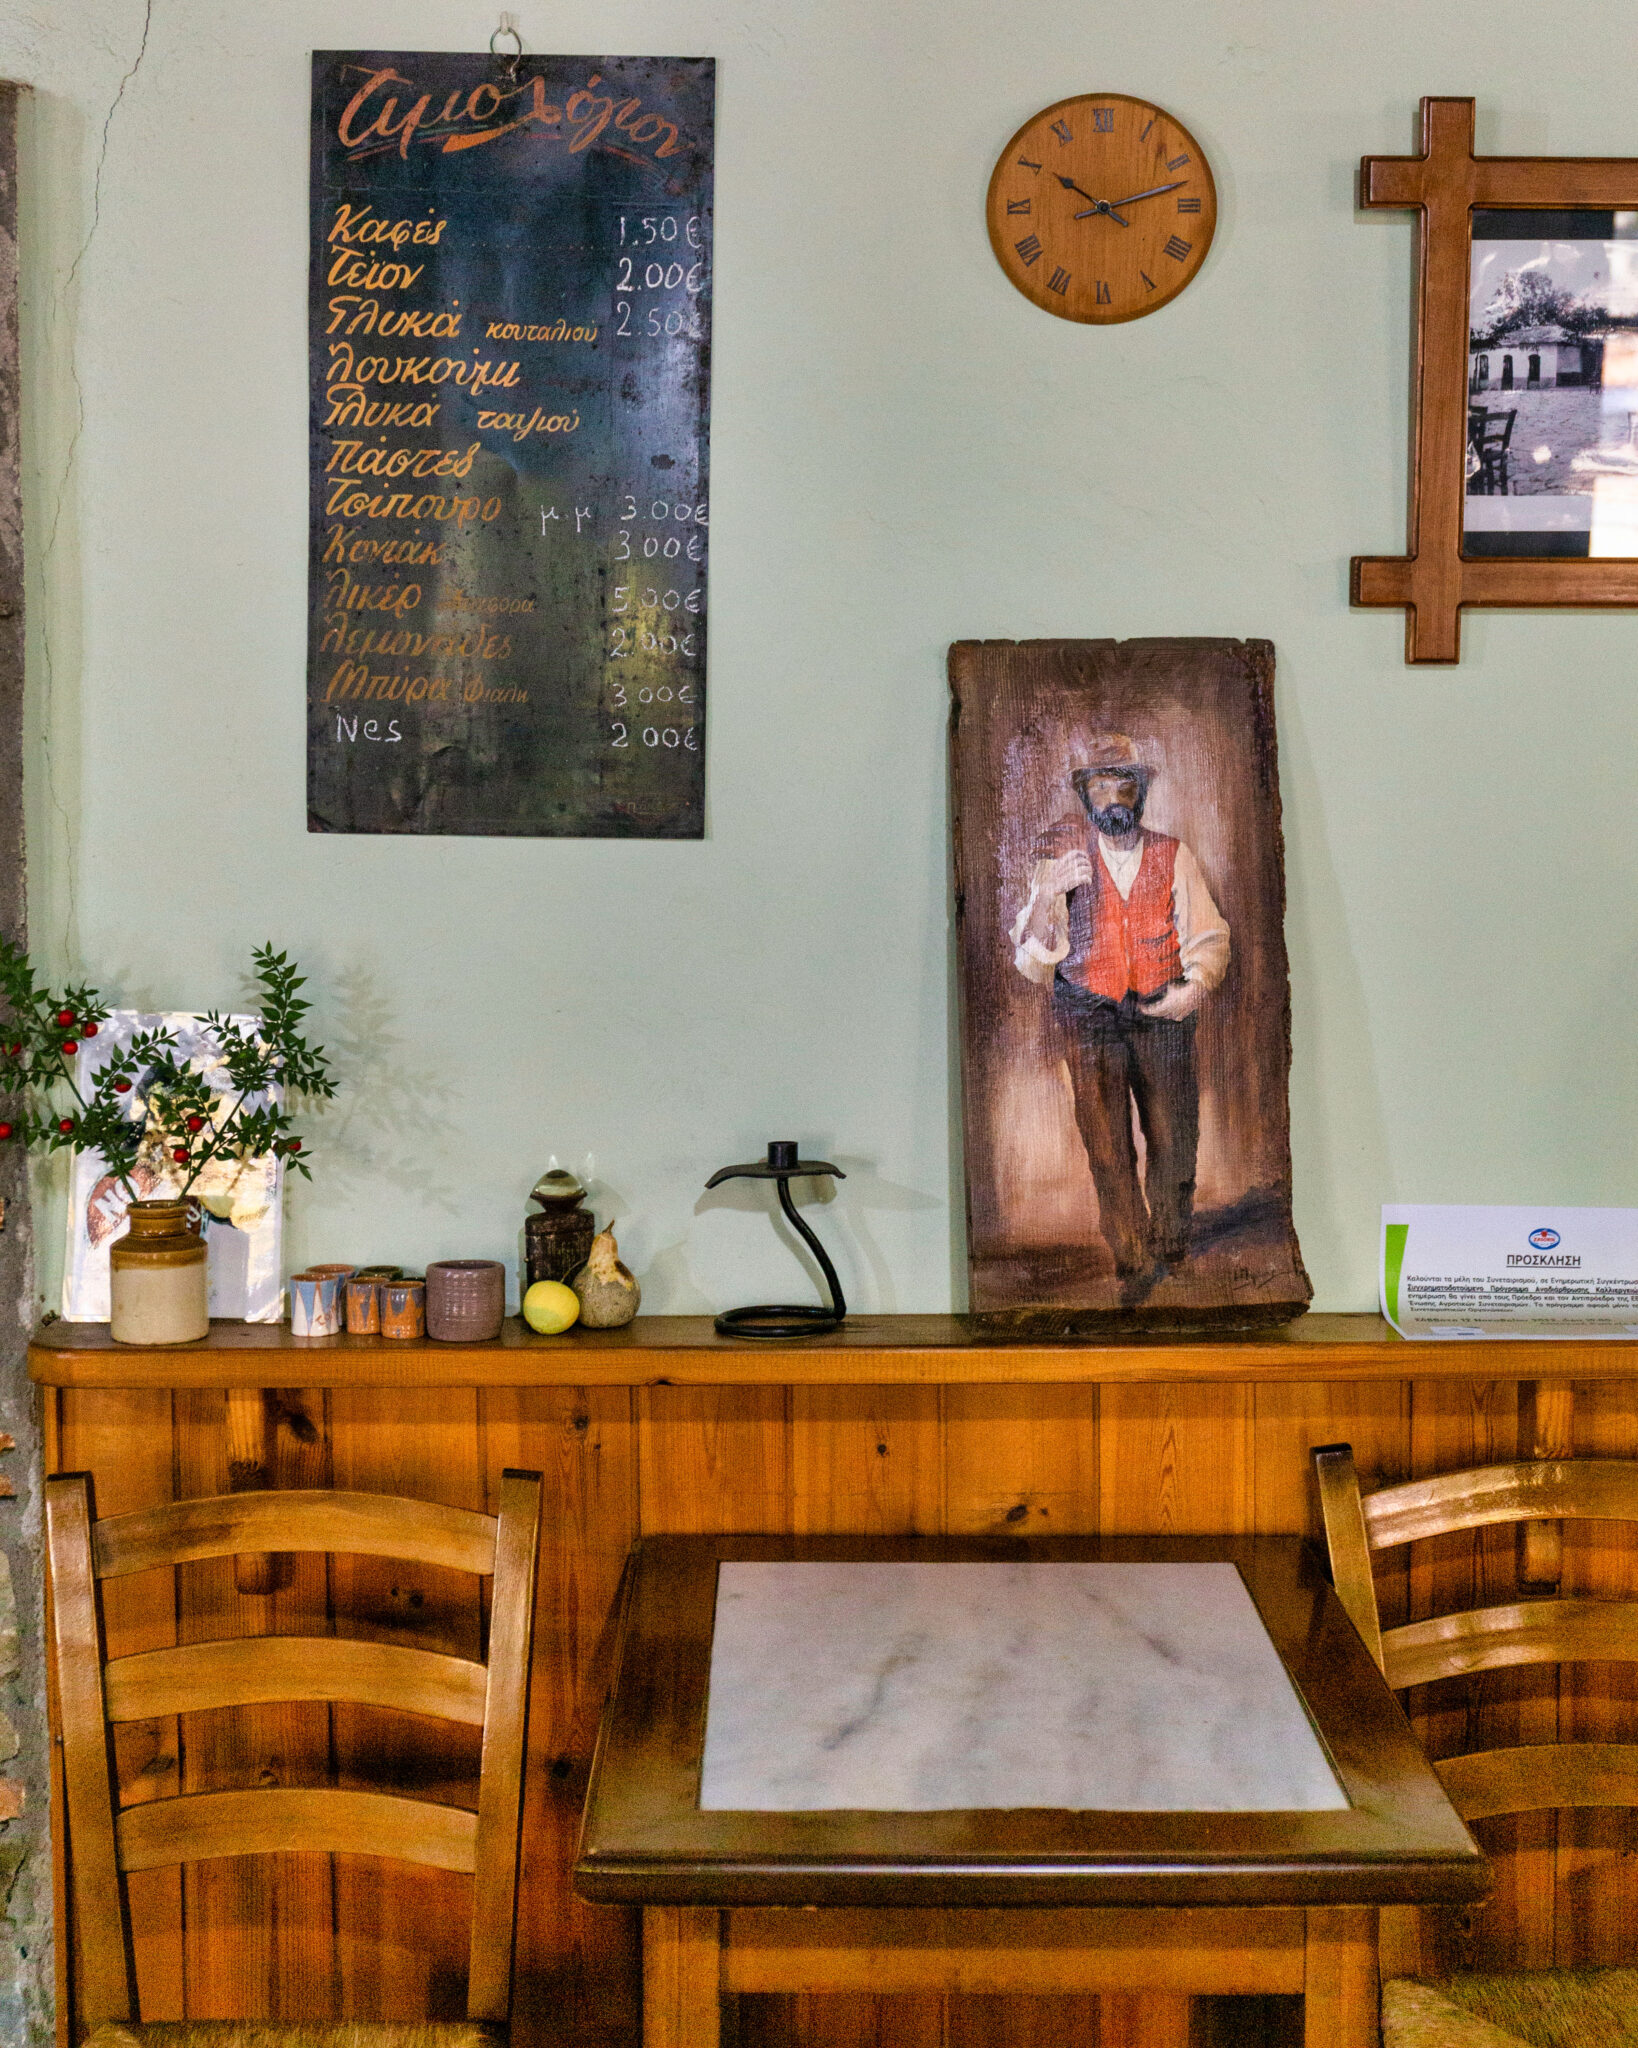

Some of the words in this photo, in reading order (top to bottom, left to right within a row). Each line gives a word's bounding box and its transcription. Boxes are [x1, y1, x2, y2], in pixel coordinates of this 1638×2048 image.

[326, 203, 448, 250] Καφές
[325, 295, 460, 339] Γλυκά
[485, 318, 598, 342] κουταλιού
[325, 341, 520, 395] Λουκούμι
[323, 382, 440, 428] Γλυκά
[477, 406, 580, 441] ταψιού
[324, 434, 481, 478] Πάστες
[325, 477, 501, 528] Τσίπουρο
[336, 714, 402, 742] Nes
[1506, 1255, 1582, 1266] ΠΡΟΣΚΛΗΣΗ
